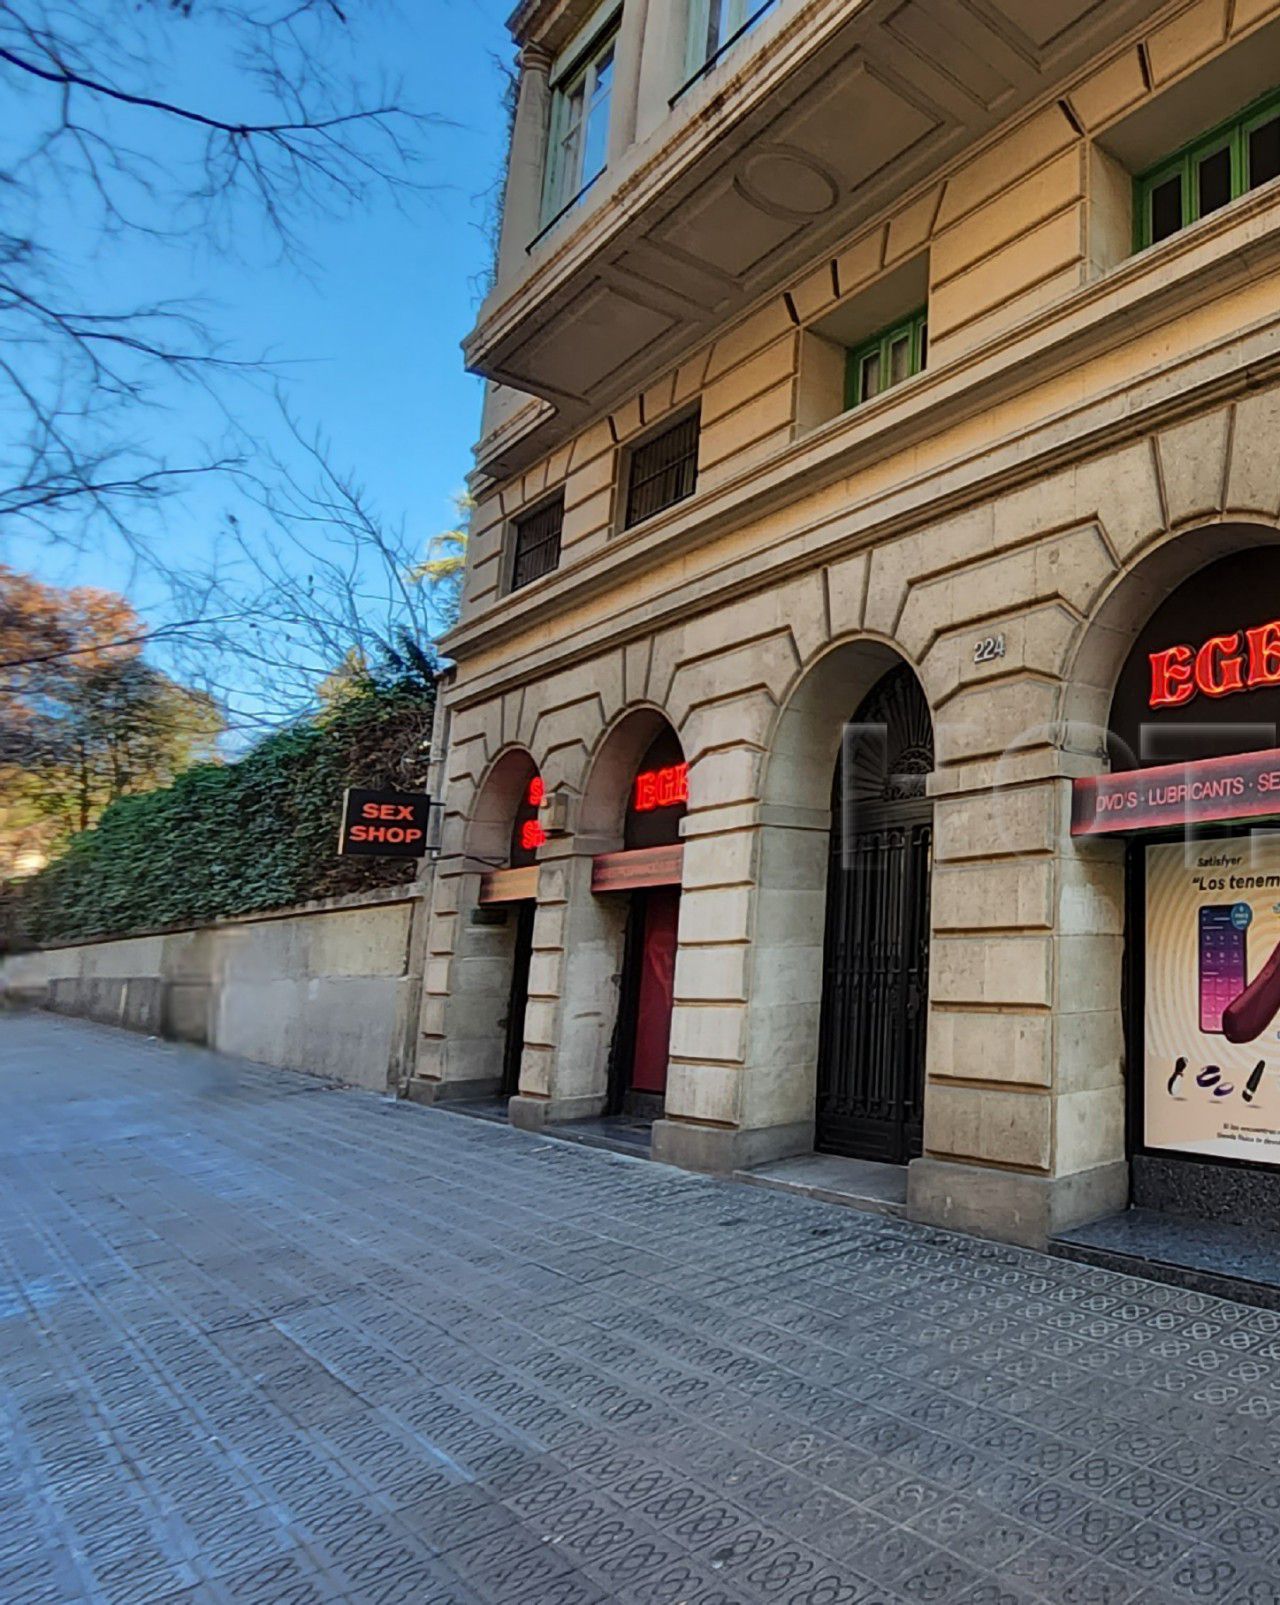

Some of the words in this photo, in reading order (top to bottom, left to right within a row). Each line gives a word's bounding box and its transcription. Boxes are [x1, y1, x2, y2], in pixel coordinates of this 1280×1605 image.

[973, 634, 1005, 662] 224
[1096, 791, 1138, 812] DVD'S
[1148, 777, 1244, 806] LUBRICANTS
[361, 802, 414, 821] SEX
[350, 825, 423, 844] SHOP
[1197, 854, 1242, 868] Satisfyer
